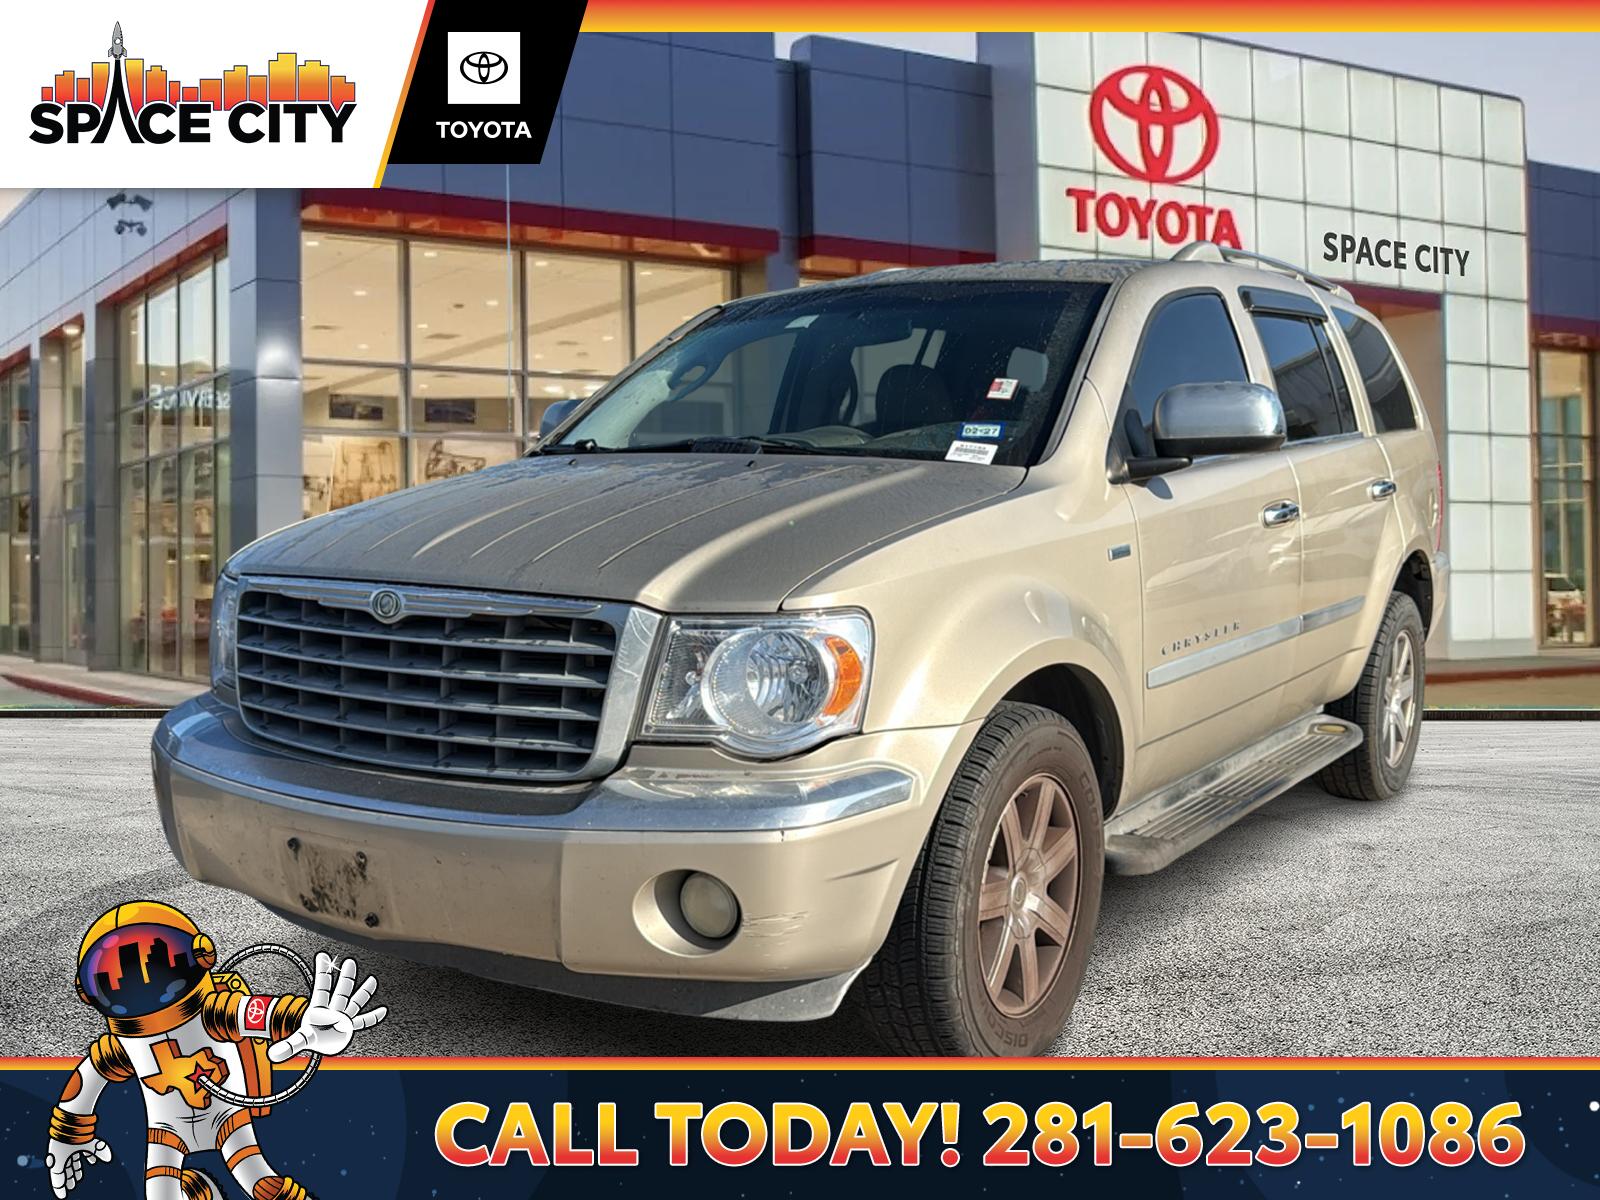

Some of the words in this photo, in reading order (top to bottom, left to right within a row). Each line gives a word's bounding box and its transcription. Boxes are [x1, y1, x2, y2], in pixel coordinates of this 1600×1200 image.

[1065, 187, 1243, 250] TOYOTA
[1322, 231, 1408, 270] SPACE
[1414, 243, 1471, 277] CITY
